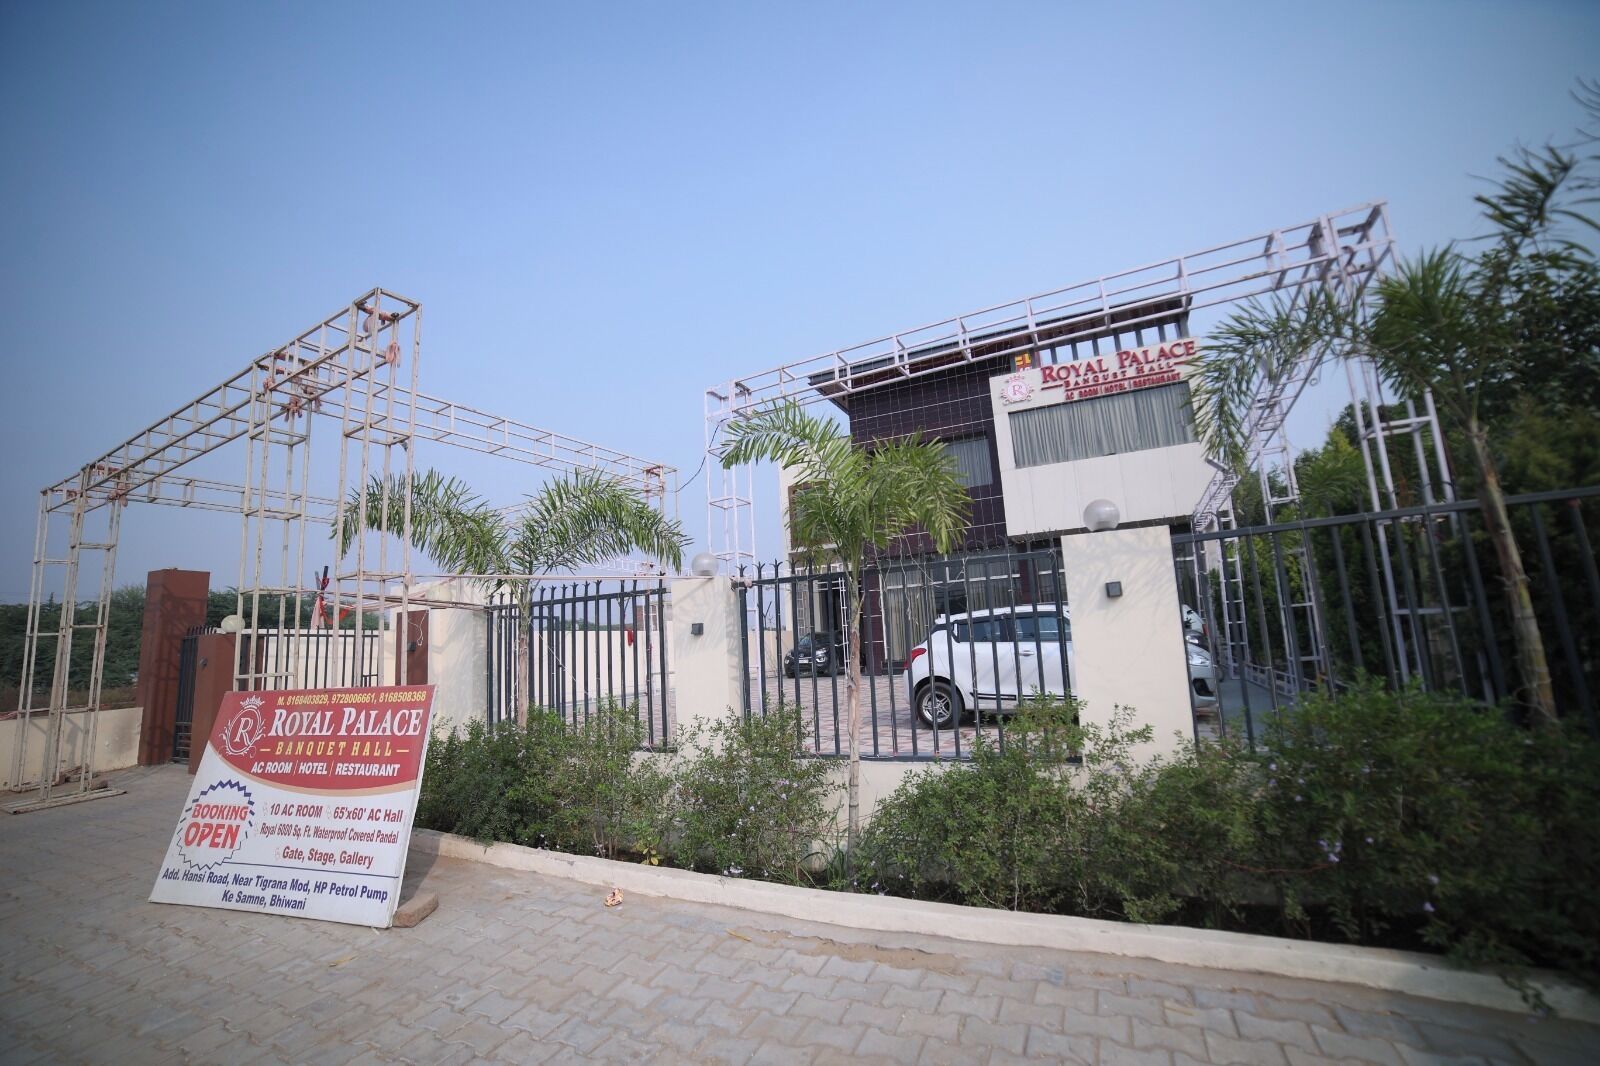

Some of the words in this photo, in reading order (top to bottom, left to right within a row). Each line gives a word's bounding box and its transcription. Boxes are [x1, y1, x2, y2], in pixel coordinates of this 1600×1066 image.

[1041, 358, 1109, 384] ROYAL
[1117, 341, 1197, 369] PALACE
[1136, 362, 1173, 374] HALL
[1065, 391, 1074, 400] AC
[1079, 387, 1098, 398] ROOM
[1104, 383, 1127, 393] HOTEL
[1133, 372, 1181, 387] RESTAURANT
[268, 709, 334, 736] ROYAL
[337, 707, 424, 736] PALACE
[275, 741, 346, 756] BANQUET
[351, 741, 392, 757] HALL
[251, 762, 265, 774] AC
[265, 762, 293, 774] ROOM
[299, 763, 328, 775] HOTEL
[335, 763, 400, 777] RESTAURANT
[191, 803, 249, 821] BOOKING
[270, 803, 279, 816] 10
[281, 804, 294, 817] AC
[296, 805, 323, 819] ROOM
[367, 808, 381, 821] AC
[383, 808, 404, 823] Hall
[184, 822, 240, 849] OPEN
[260, 822, 277, 837] Royal
[313, 825, 348, 842] Waterproof
[348, 827, 374, 843] Covered
[376, 830, 398, 844] Pandal
[282, 846, 305, 860] Gate,
[307, 849, 336, 864] Stage,
[339, 850, 374, 869] Gallery
[162, 868, 180, 880] Add.
[182, 869, 207, 883] Hansi
[206, 871, 230, 887] Road,
[231, 873, 253, 887] Near
[255, 875, 287, 891] Tigrana
[289, 878, 311, 894] Mod,
[313, 880, 328, 894] HP
[329, 882, 358, 897] Petrol
[360, 885, 388, 903] Pump
[221, 889, 234, 903] Ke
[235, 892, 267, 907] Samne,
[269, 894, 307, 910] Bhiwani
